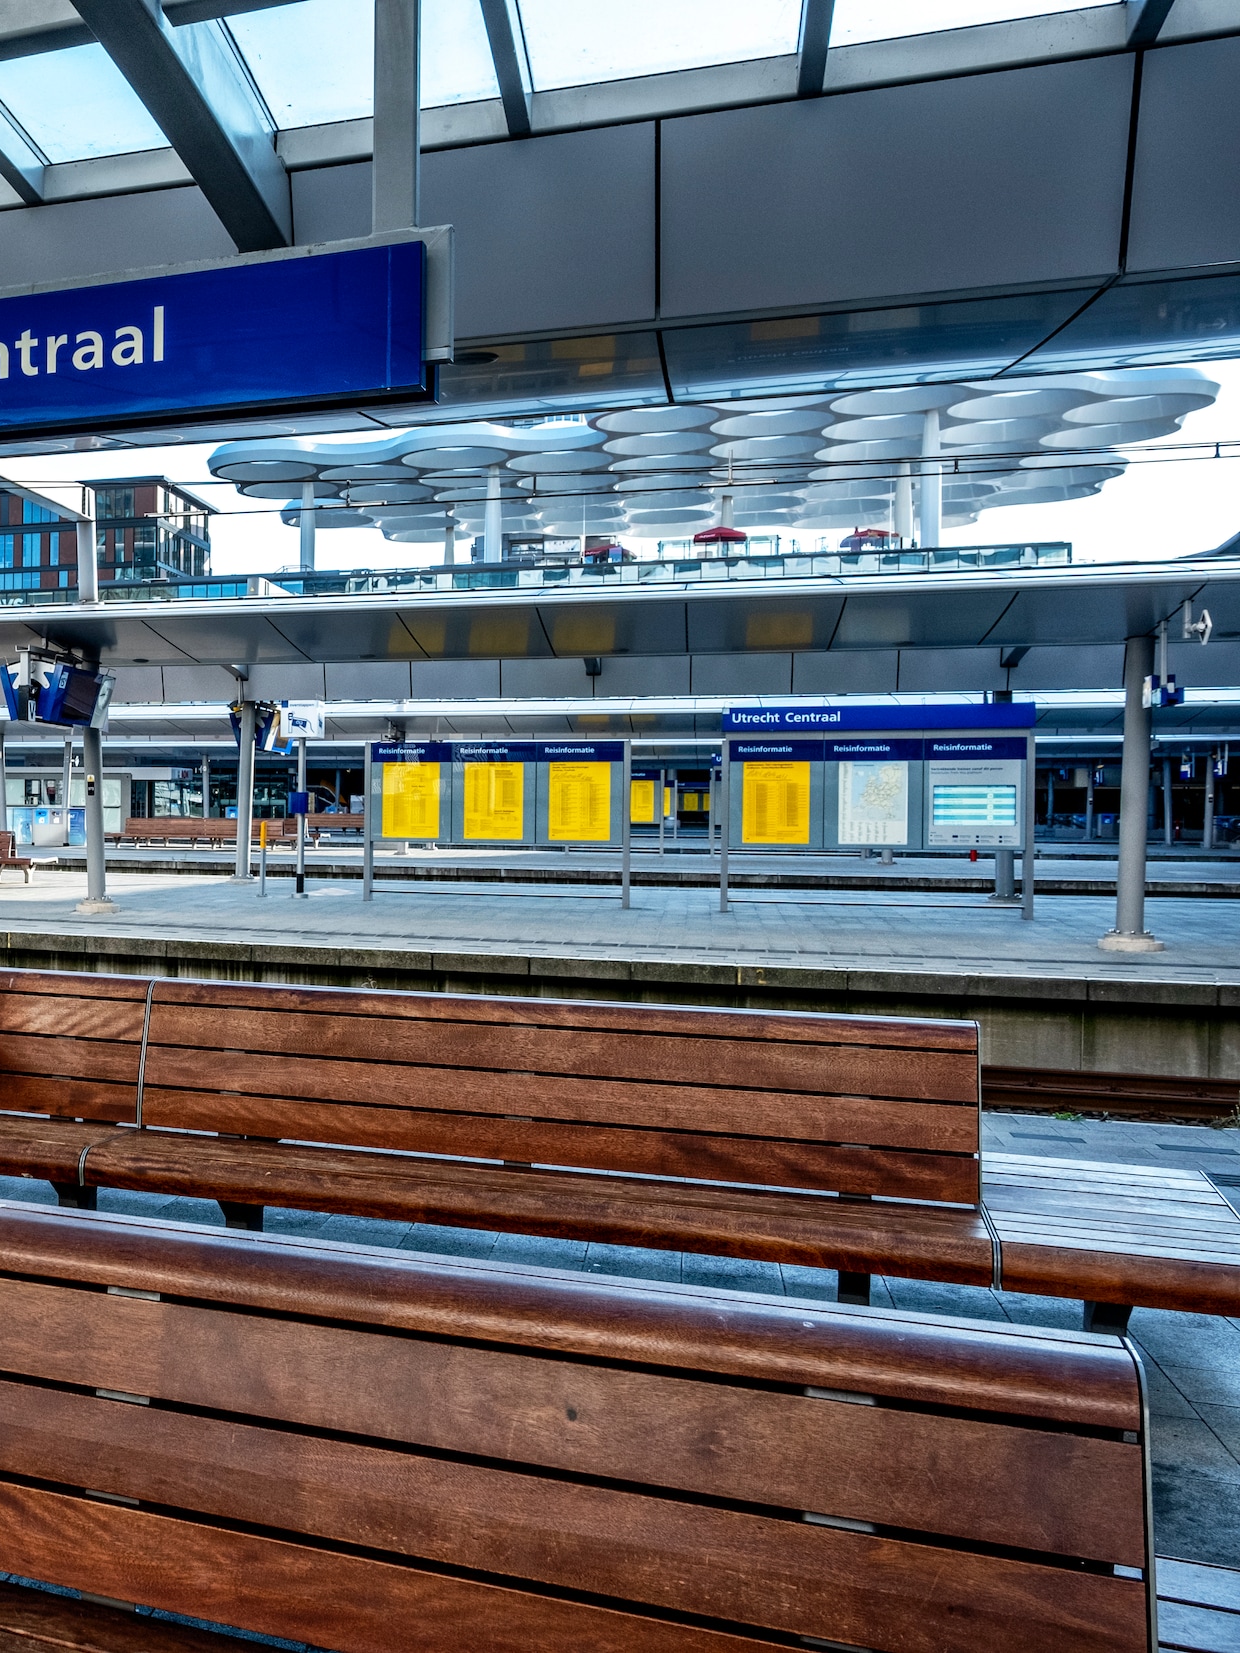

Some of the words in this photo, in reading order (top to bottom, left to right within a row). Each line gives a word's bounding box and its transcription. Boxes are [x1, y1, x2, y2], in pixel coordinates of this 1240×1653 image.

[731, 712, 780, 724] Utrecht
[785, 711, 841, 723] Centraal
[378, 747, 426, 755] Reisinformatie
[460, 747, 509, 755] Reisinformatie
[833, 744, 891, 752] Reisinformatie
